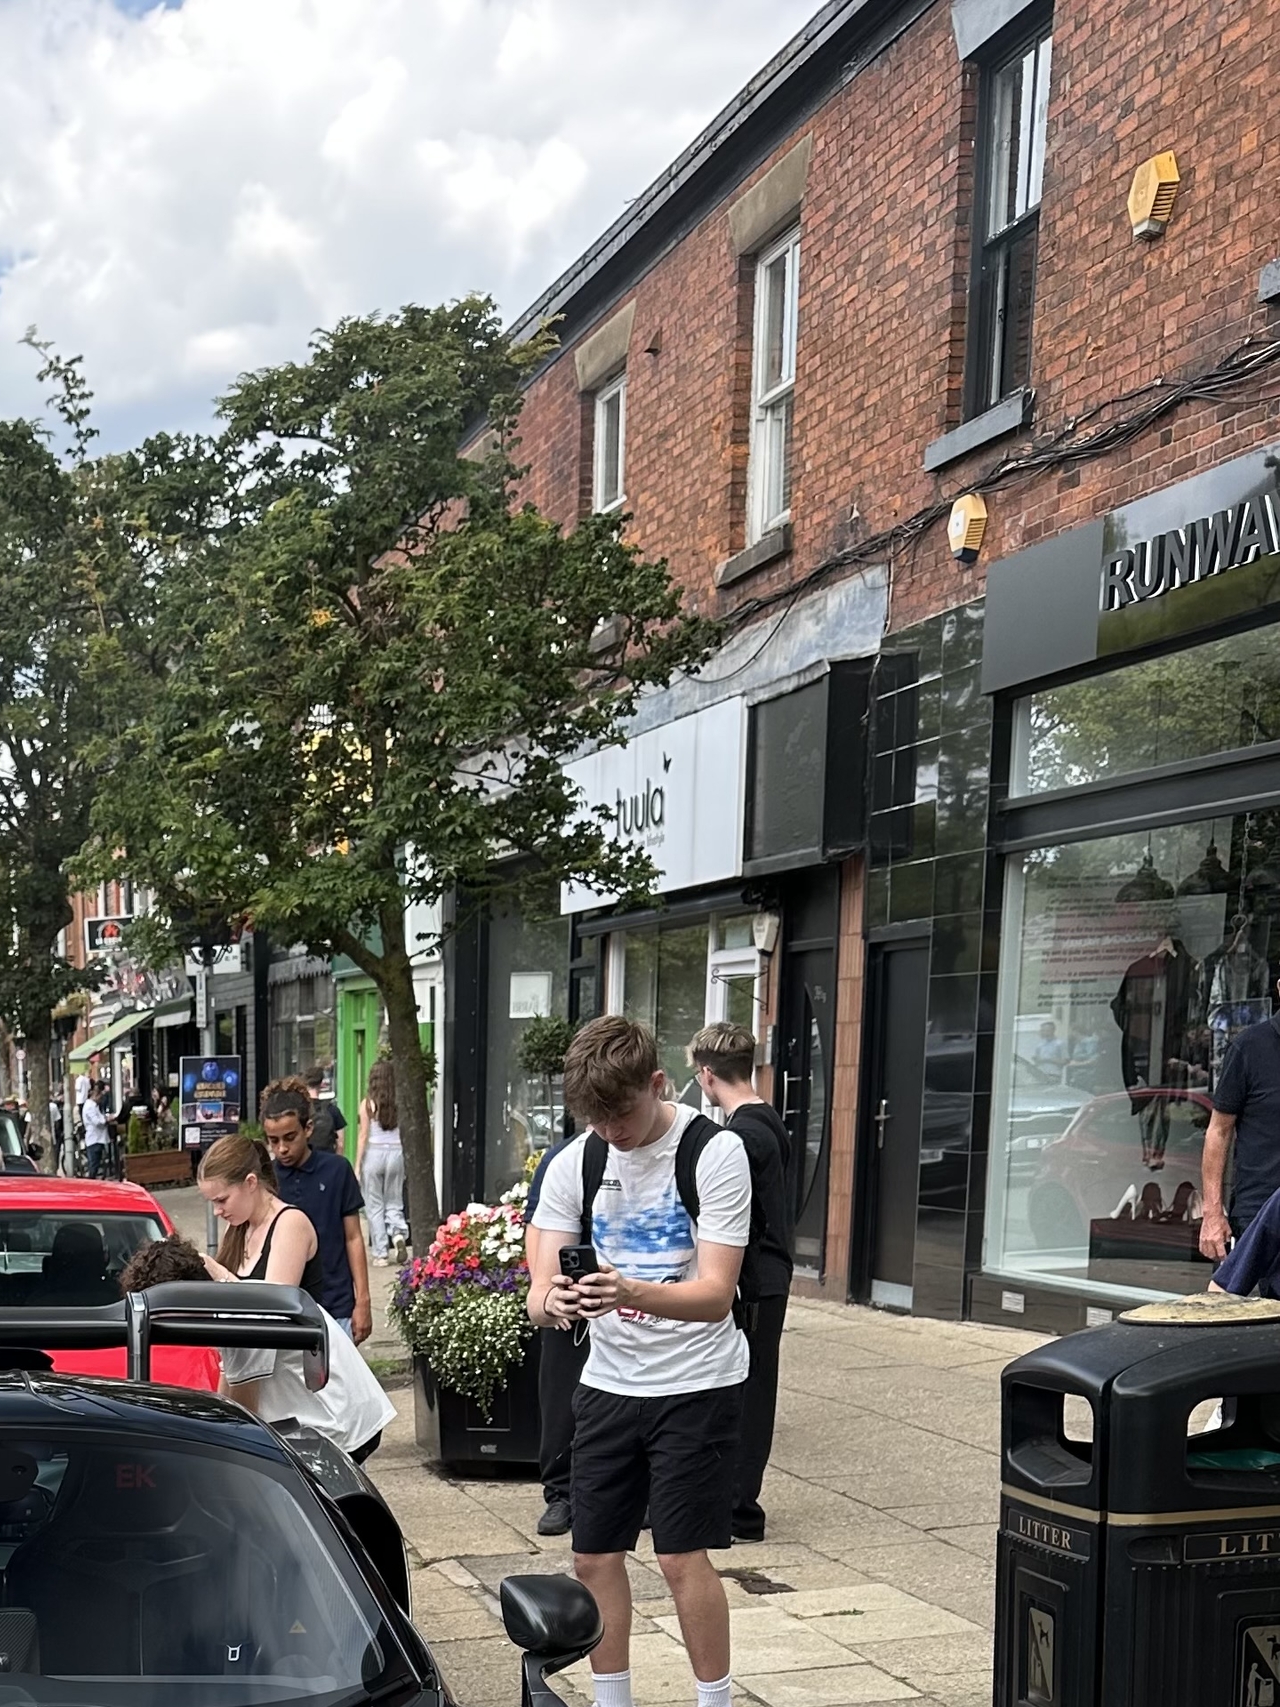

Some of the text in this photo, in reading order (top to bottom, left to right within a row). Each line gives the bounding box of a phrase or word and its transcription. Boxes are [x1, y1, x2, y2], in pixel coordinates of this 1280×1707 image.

[616, 778, 664, 837] tuula
[116, 1464, 156, 1487] EK
[1019, 1516, 1071, 1549] LITTER
[1218, 1532, 1280, 1555] LIT
